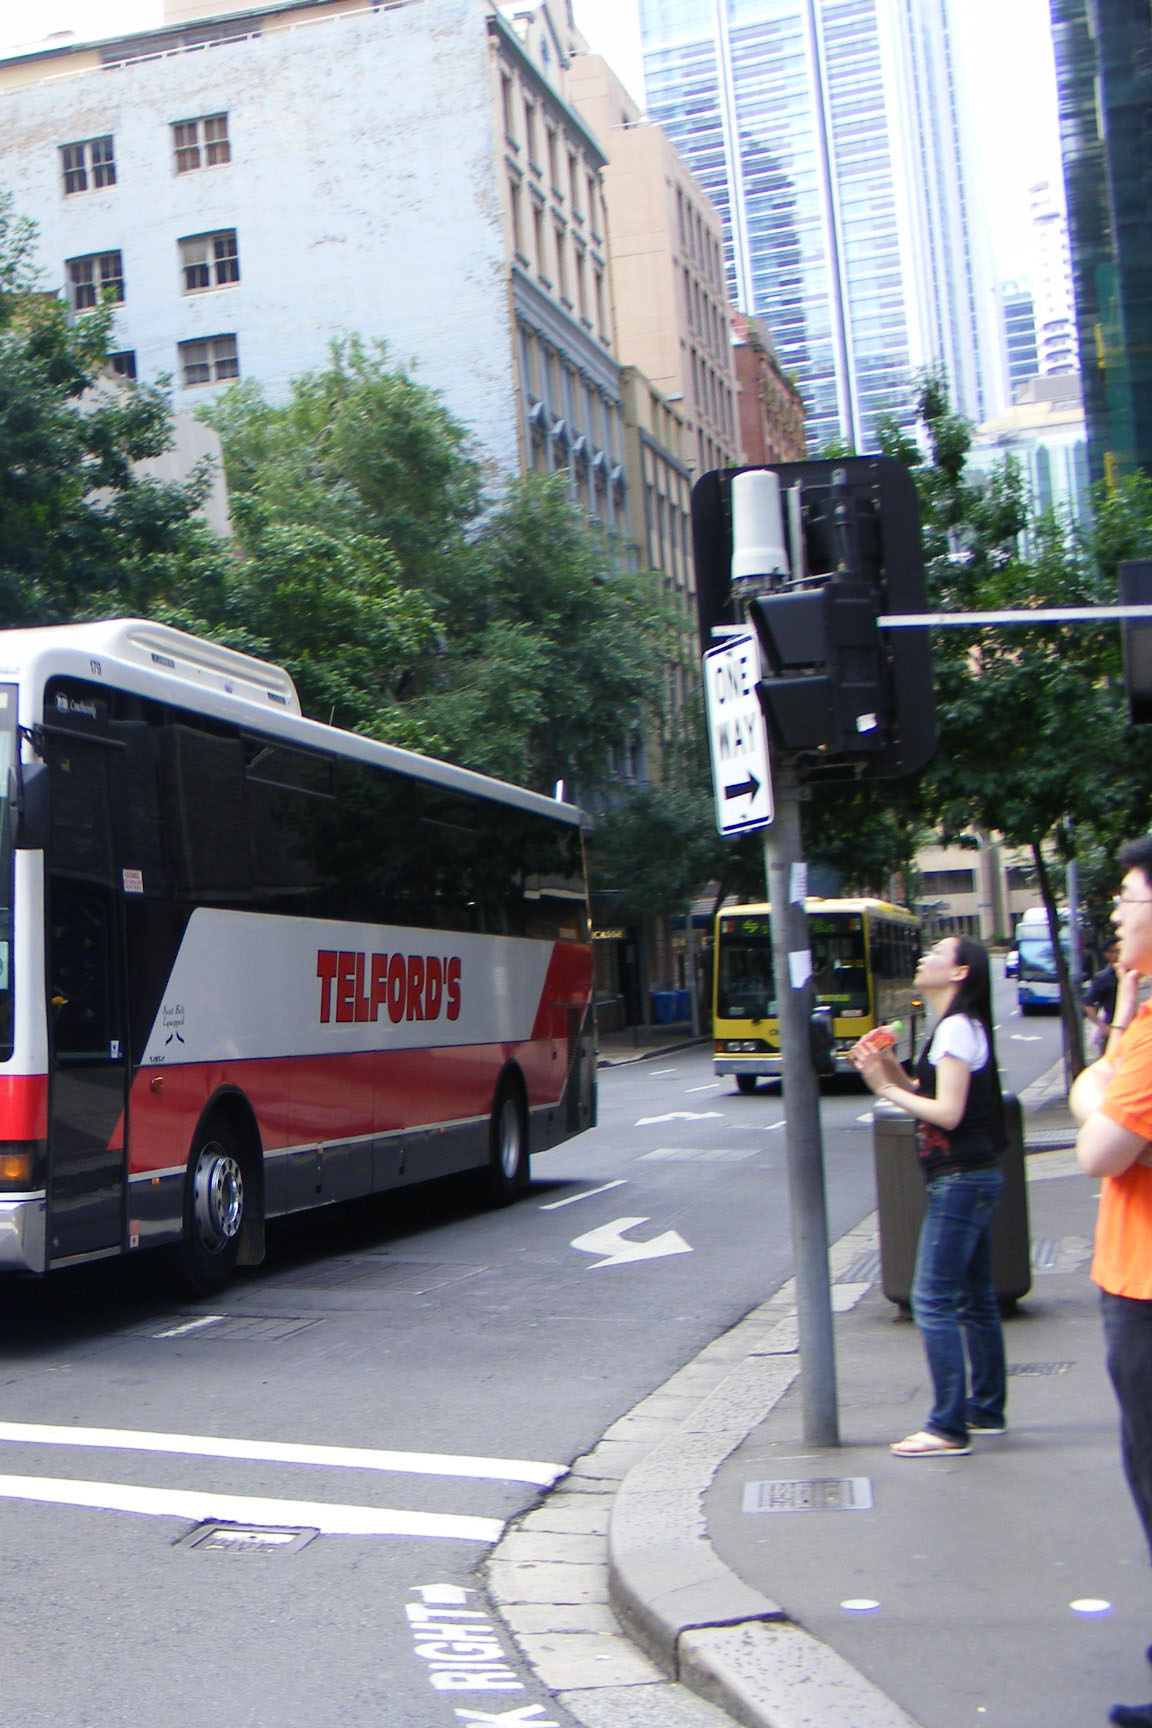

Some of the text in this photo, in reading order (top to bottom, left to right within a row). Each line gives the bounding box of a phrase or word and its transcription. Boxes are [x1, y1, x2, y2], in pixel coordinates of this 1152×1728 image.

[89, 659, 102, 676] 179
[715, 656, 751, 704] ONE
[717, 713, 757, 760] WAY
[316, 949, 462, 1024] TELFORD'S
[404, 1602, 526, 1692] RIGHT
